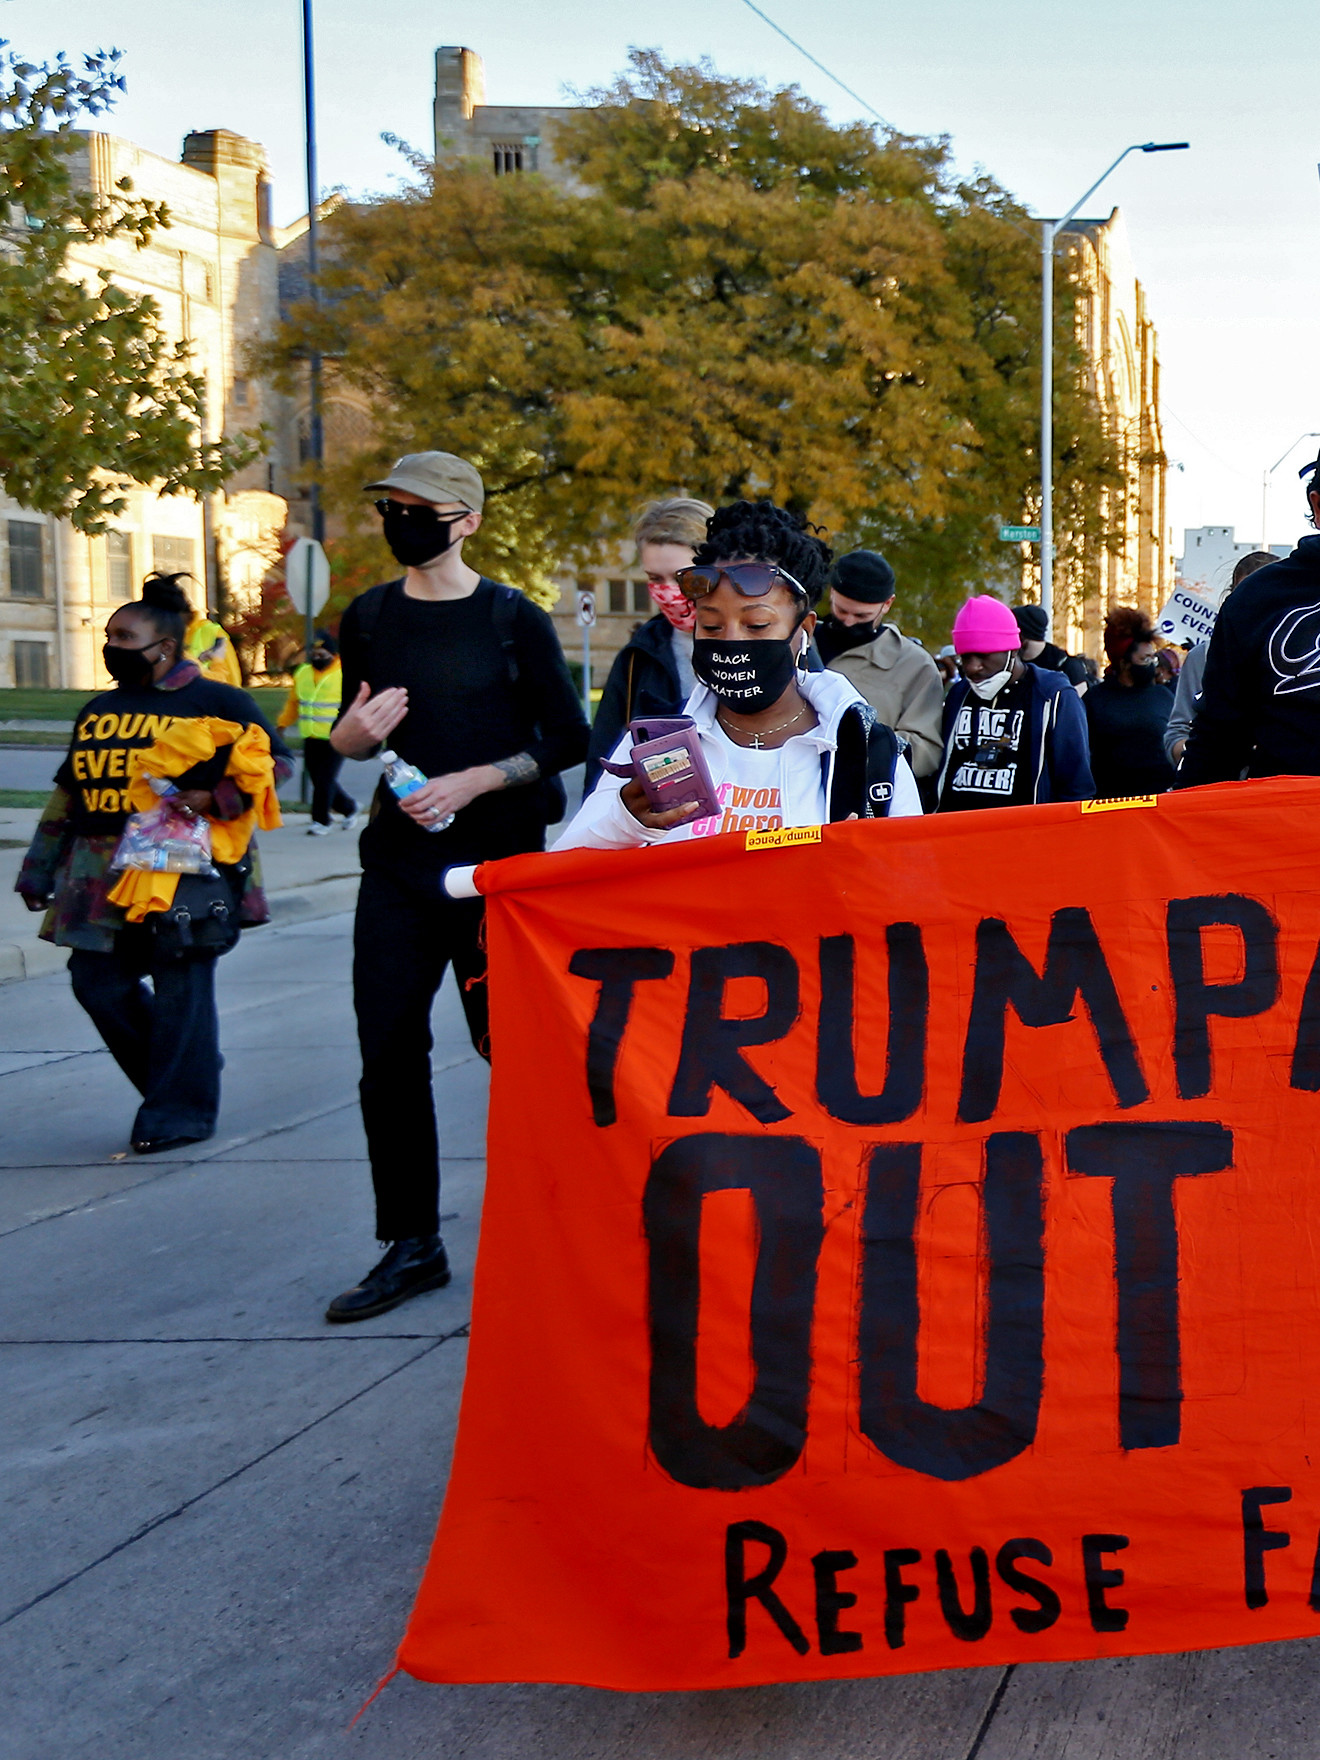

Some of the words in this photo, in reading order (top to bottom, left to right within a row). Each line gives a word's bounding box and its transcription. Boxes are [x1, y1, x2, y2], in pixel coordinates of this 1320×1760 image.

[1181, 614, 1215, 637] EVER
[712, 652, 751, 665] BLACK
[711, 669, 756, 682] WOMEN
[710, 683, 763, 699] MATTER
[79, 713, 174, 741] COUN
[748, 830, 821, 845] Trump/Pence
[641, 1120, 1234, 1493] OUT
[724, 1519, 1130, 1660] REFUSE
